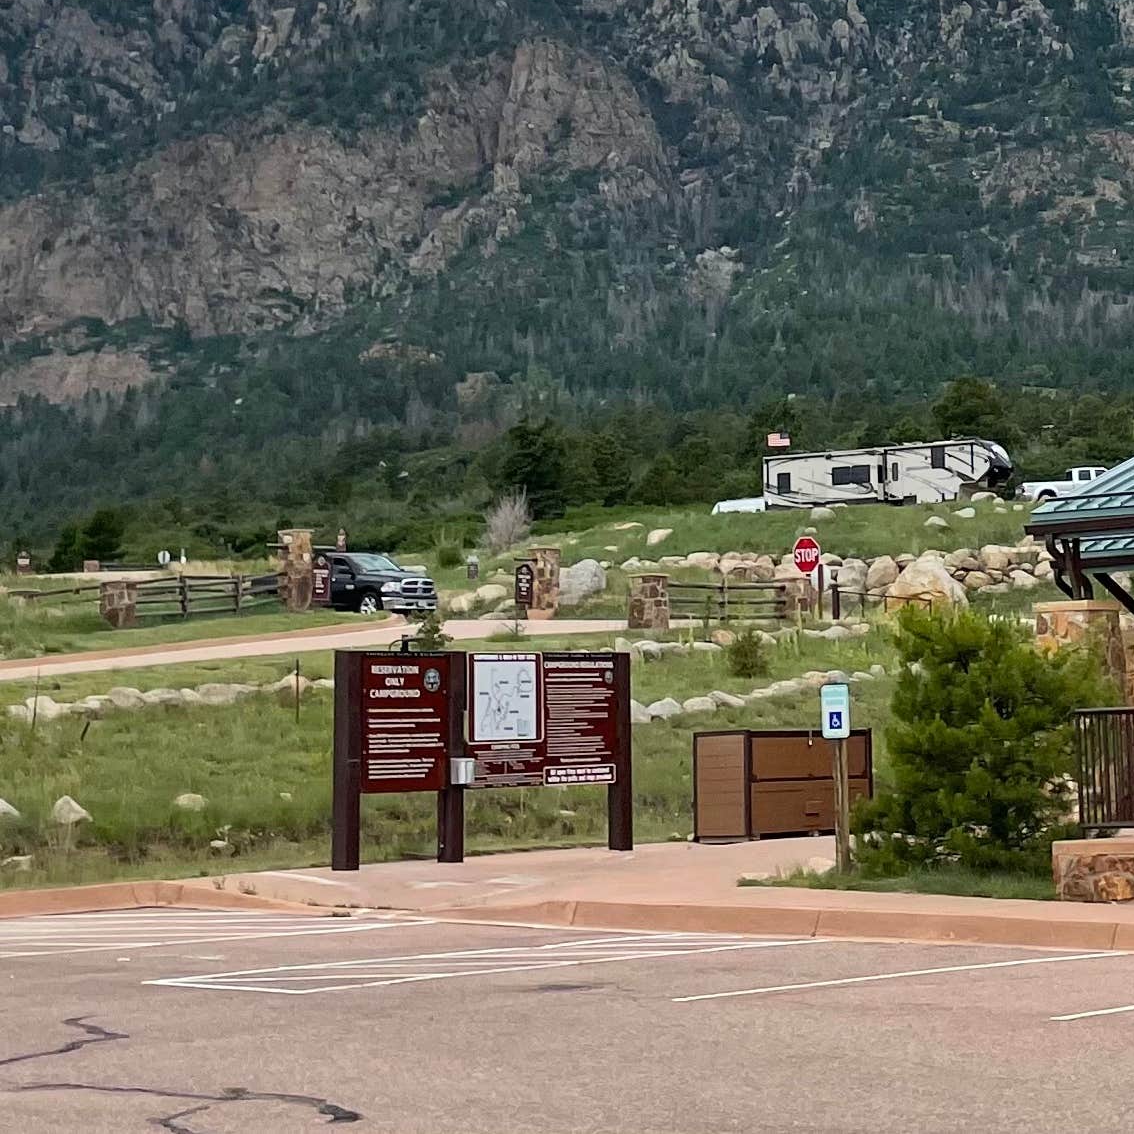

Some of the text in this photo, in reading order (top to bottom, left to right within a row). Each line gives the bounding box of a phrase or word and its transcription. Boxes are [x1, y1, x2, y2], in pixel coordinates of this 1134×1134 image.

[795, 548, 818, 563] STOP
[371, 665, 419, 675] RESERVATION
[385, 677, 404, 686] ONLY
